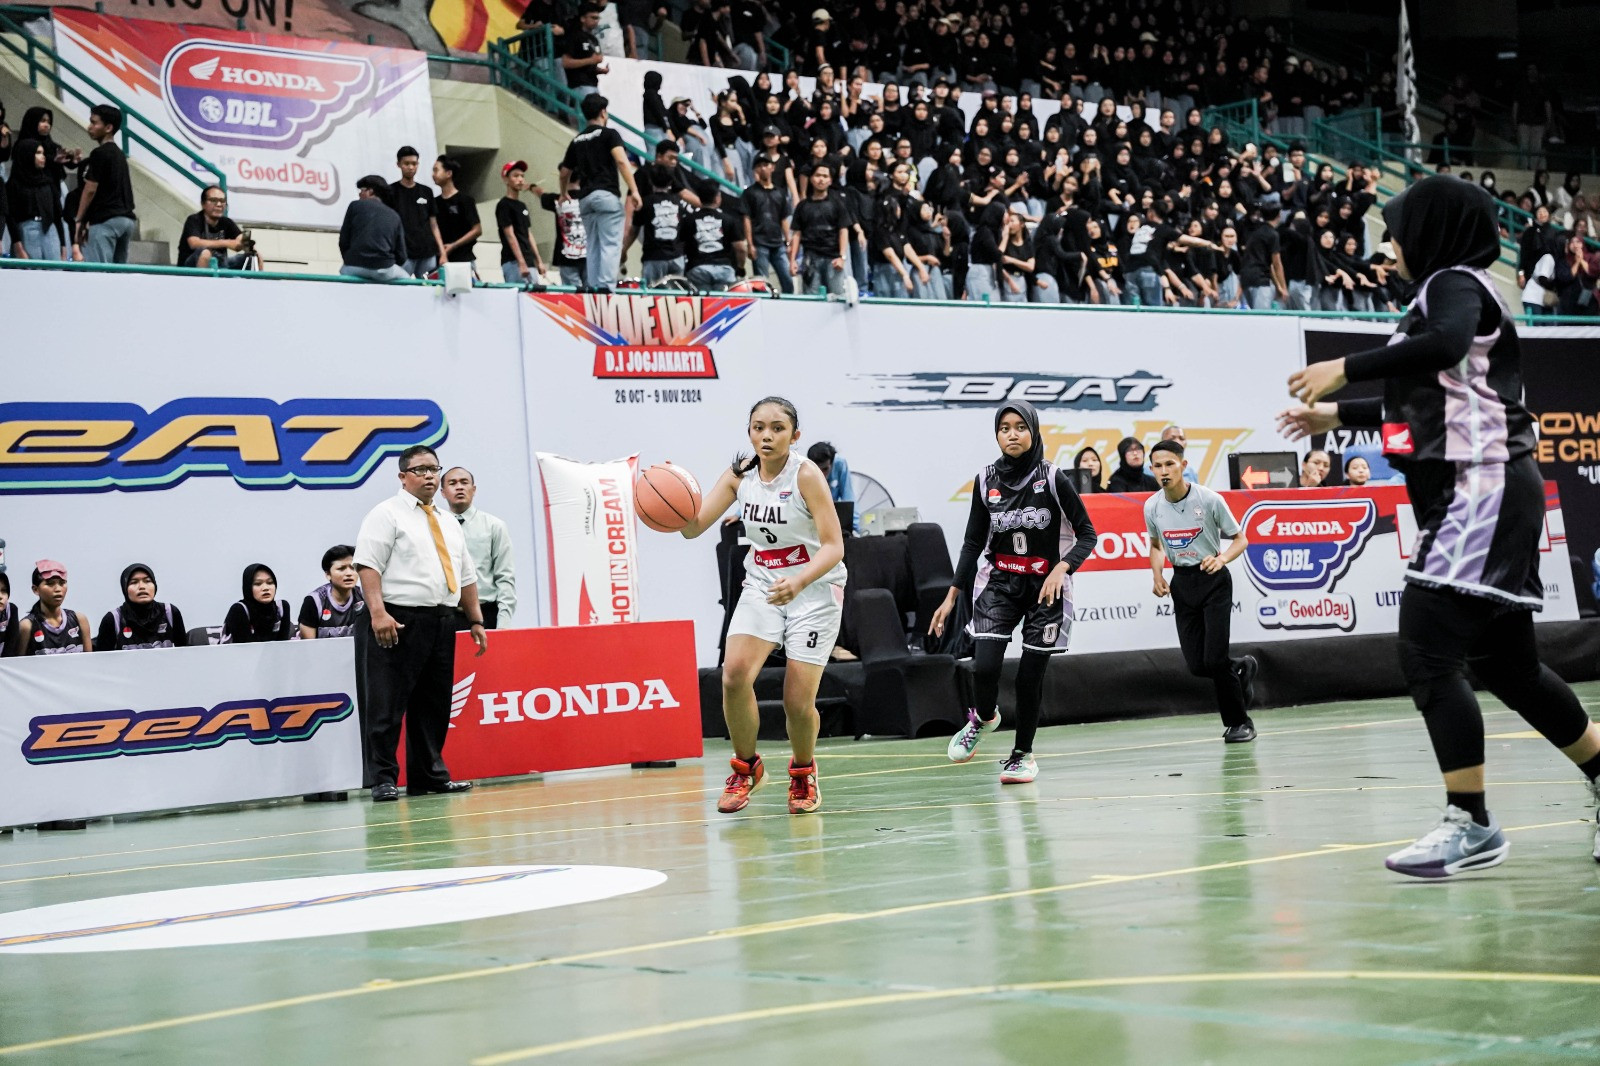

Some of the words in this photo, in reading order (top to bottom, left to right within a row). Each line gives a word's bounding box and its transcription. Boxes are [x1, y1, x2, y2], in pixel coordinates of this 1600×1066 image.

[220, 66, 326, 92] HONDA
[224, 98, 278, 128] DBL
[605, 350, 624, 372] D.I
[626, 351, 706, 372] JOGJAKARTA
[615, 389, 626, 403] 26
[628, 390, 645, 403] OCT
[654, 390, 660, 402] 9
[662, 390, 679, 402] NOV
[681, 389, 702, 402] 2024
[598, 478, 627, 555] CREAM
[742, 502, 788, 525] FILIAL
[759, 526, 778, 544] 3
[1276, 520, 1345, 536] HONDA
[1012, 531, 1028, 555] 0
[1280, 548, 1315, 571] DBL
[611, 582, 631, 624] HOT
[807, 631, 819, 648] 3
[1043, 622, 1060, 645] 0
[478, 678, 681, 726] HONDA
[29, 699, 346, 752] BeAT
